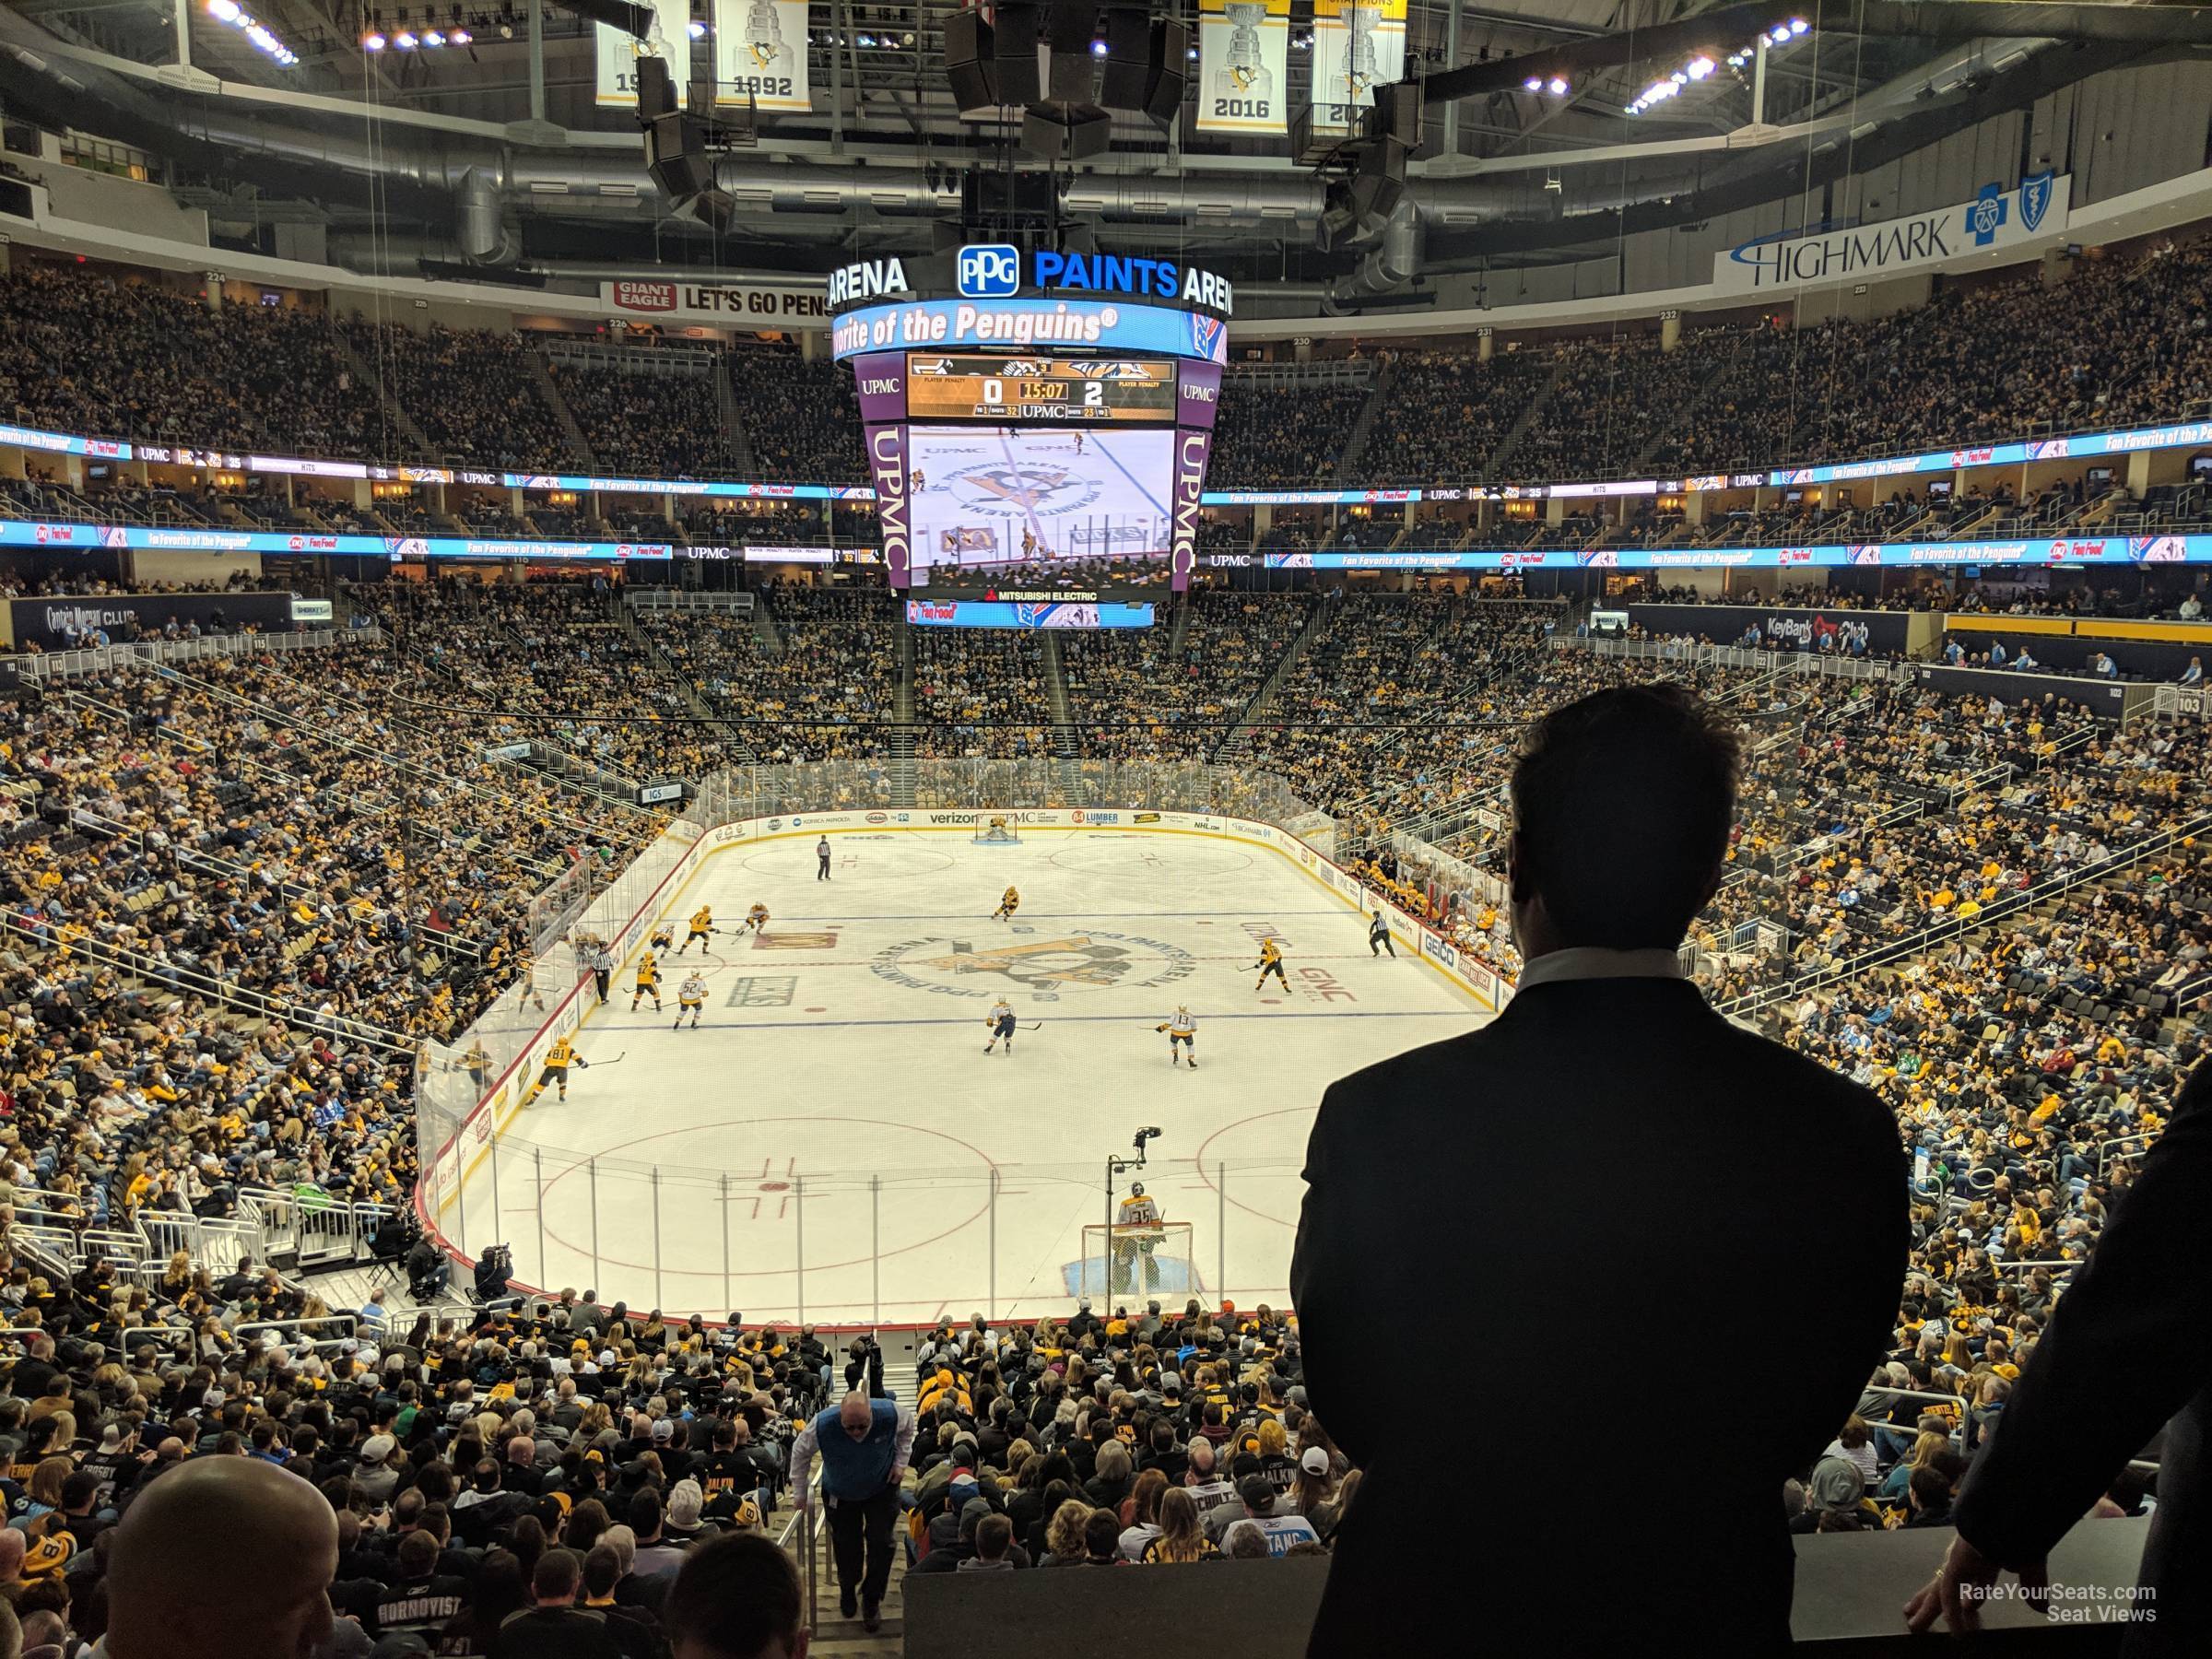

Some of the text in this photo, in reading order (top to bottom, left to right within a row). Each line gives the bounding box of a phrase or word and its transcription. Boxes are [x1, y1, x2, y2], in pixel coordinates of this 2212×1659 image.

[735, 76, 792, 96] 1992
[1215, 99, 1269, 118] 2016
[1755, 215, 1950, 287] HIGHMARK
[207, 272, 226, 282] 224
[962, 251, 1015, 290] PPG
[1035, 252, 1179, 297] PAINTS
[619, 282, 672, 296] GIANT
[829, 257, 908, 308] ARENA
[621, 295, 671, 307] EAGLE
[686, 288, 742, 312] LET'S
[748, 292, 777, 314] GO
[610, 319, 628, 328] 226
[874, 312, 897, 346] of
[903, 310, 946, 341] the
[1041, 364, 1047, 372] 3
[862, 378, 900, 395] UPMC
[983, 379, 1002, 404] 0
[1024, 383, 1064, 399] 15:07
[1184, 383, 1214, 403] UPMC
[1085, 382, 1102, 406] 2
[1006, 406, 1017, 416] 32
[1022, 406, 1066, 419] UPMC
[1083, 408, 1094, 417] 23
[2107, 435, 2124, 450] Fan
[2124, 432, 2165, 448] Favorite
[2167, 429, 2179, 444] of
[2181, 428, 2198, 442] the
[141, 447, 171, 462] UPMC
[464, 473, 496, 484] UPMC
[1735, 475, 1762, 487] UPMC
[874, 427, 910, 571] UPMC
[1430, 489, 1461, 500] UPMC
[1171, 434, 1206, 575] UPMC
[688, 547, 730, 559] UPMC
[1925, 546, 1957, 560] Favorite
[1959, 546, 1968, 559] of
[1970, 546, 1981, 559] the
[1210, 555, 1251, 567] UPMC
[998, 591, 1097, 601] MITSUBISHI ELECTRIC
[47, 606, 74, 633] Captain
[1768, 618, 1812, 640] KeyBank
[253, 639, 265, 649] 115
[1554, 641, 1565, 649] 121
[52, 659, 64, 672] 113
[1874, 667, 1886, 678] 101
[2179, 698, 2200, 713] 103
[1006, 812, 1036, 823] PMC
[1087, 812, 1118, 822] LUMBER
[1425, 934, 1454, 968] GEICO
[683, 982, 697, 994] 52
[1298, 968, 1357, 1003] GNC
[1177, 1014, 1189, 1025] 13
[553, 1048, 564, 1060] 81
[1132, 1209, 1150, 1224] 35
[1267, 1467, 1297, 1484] ALKIN
